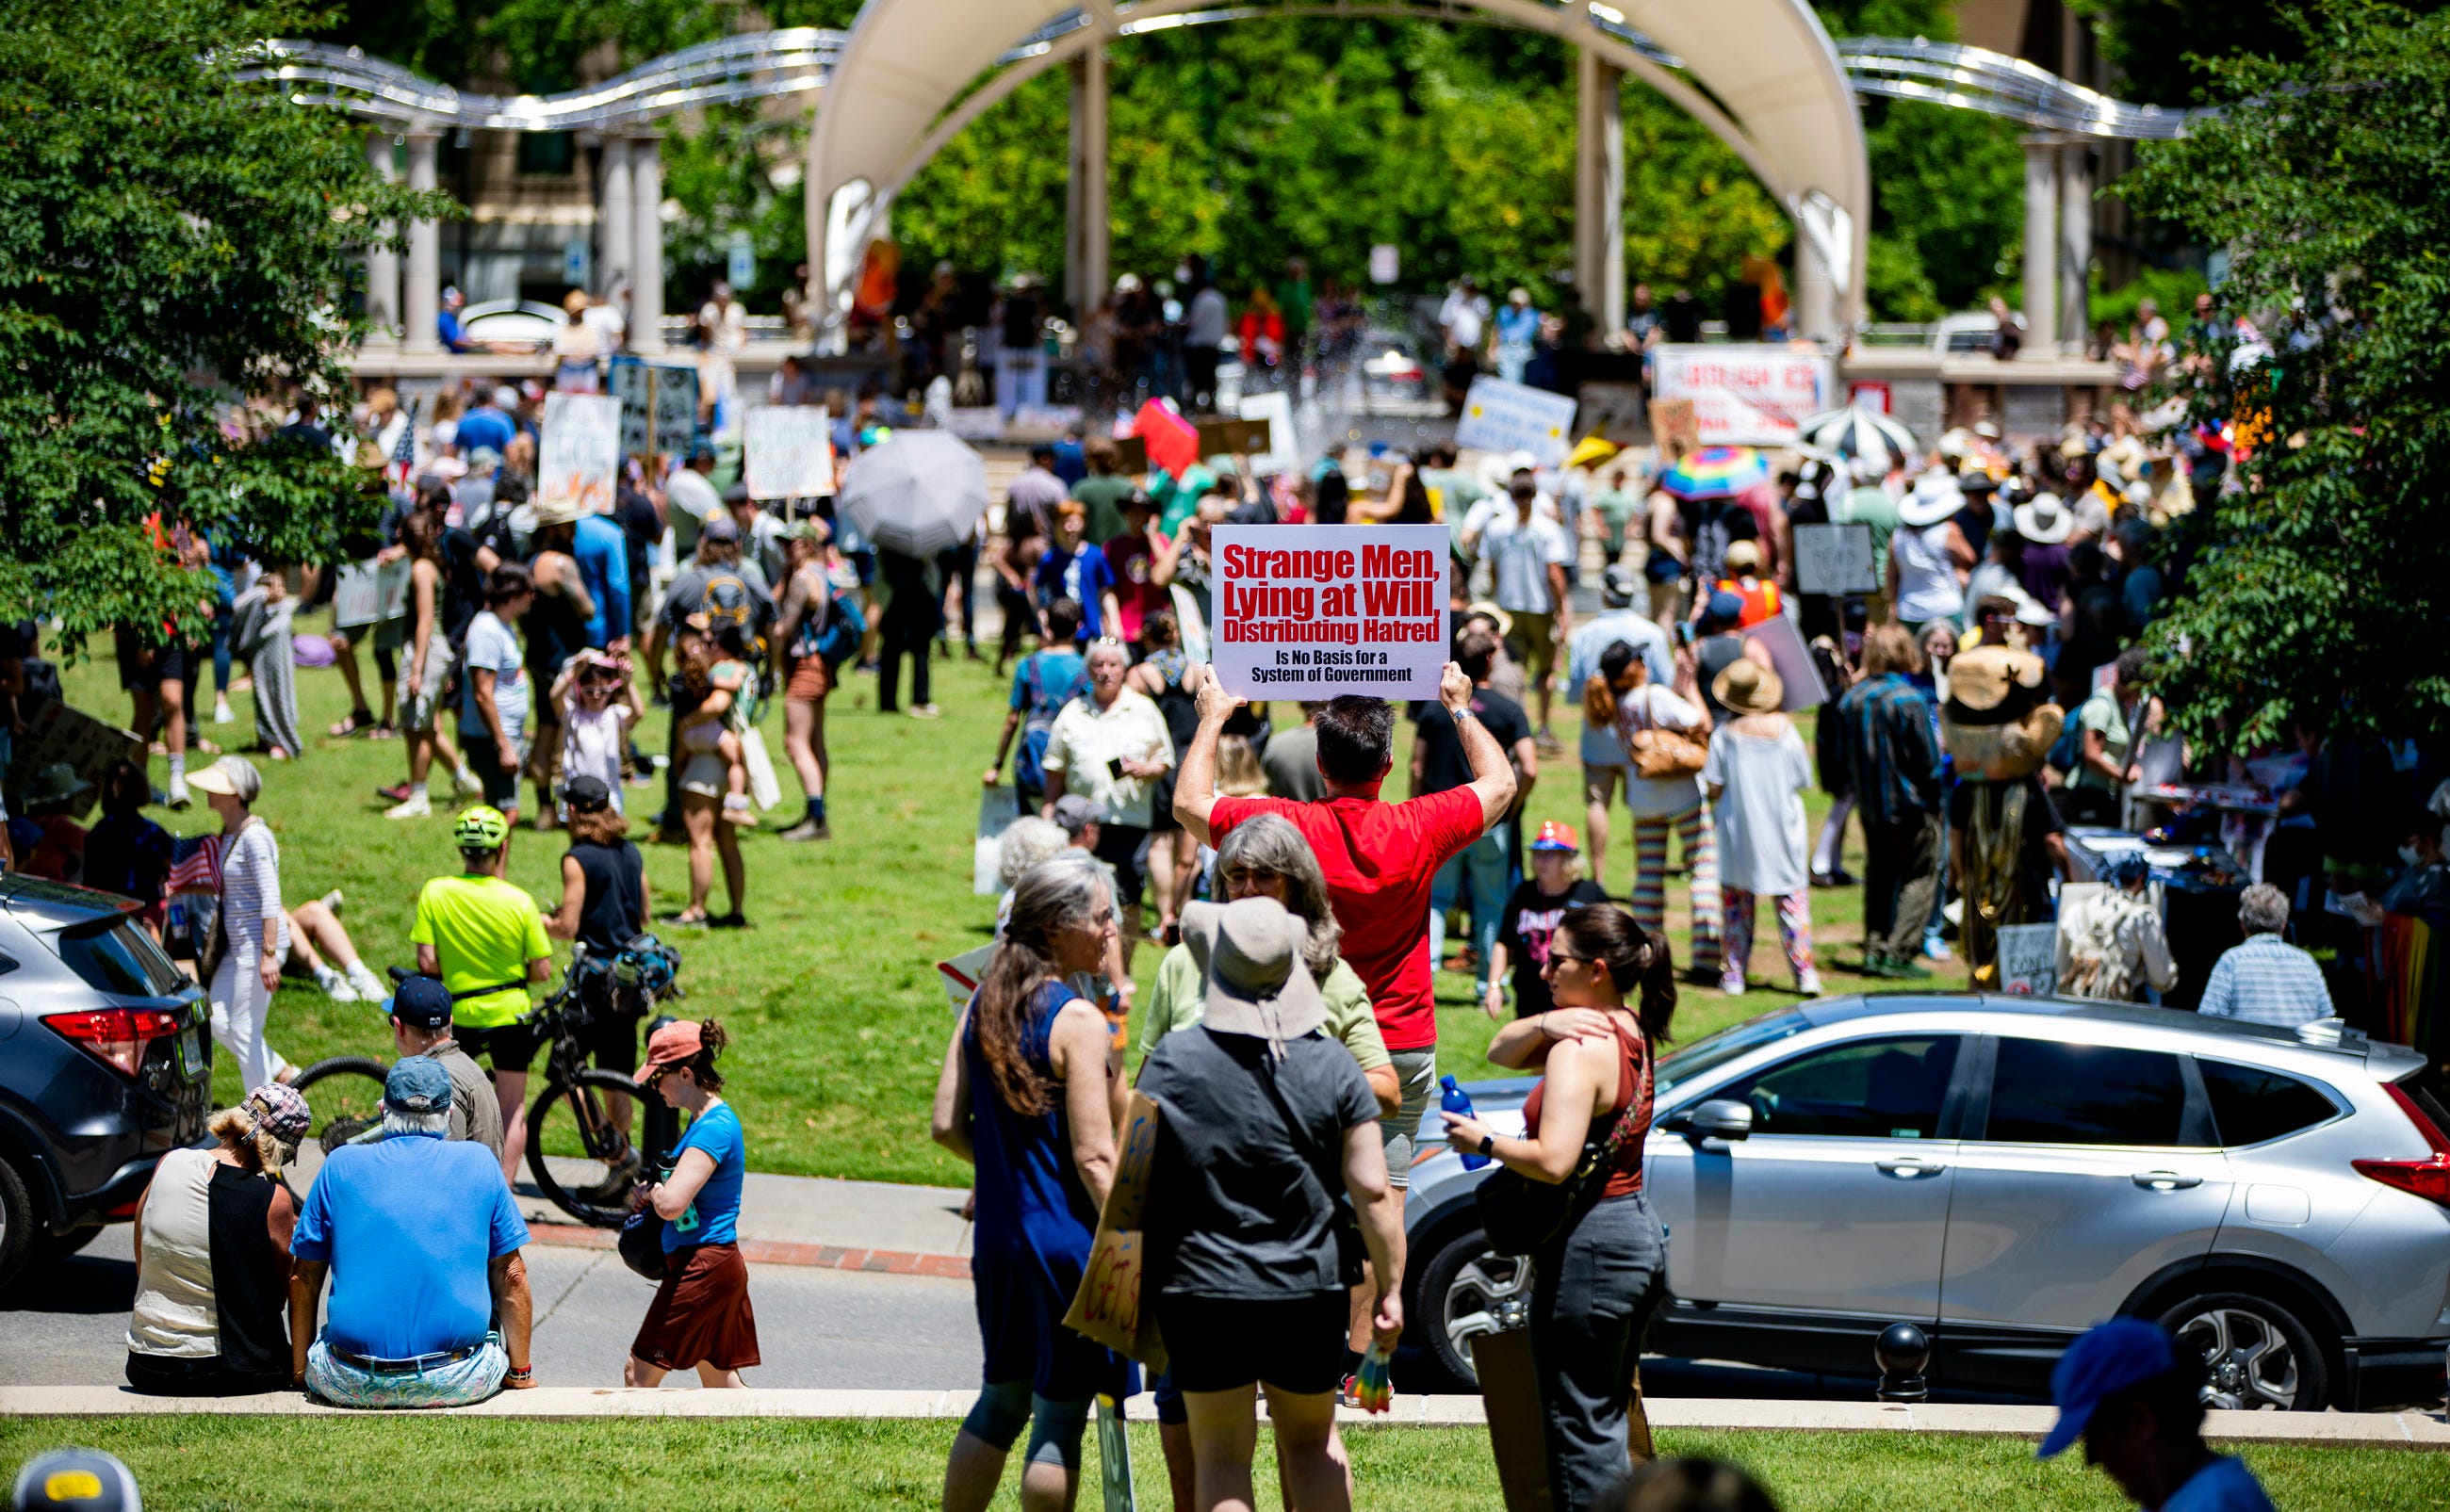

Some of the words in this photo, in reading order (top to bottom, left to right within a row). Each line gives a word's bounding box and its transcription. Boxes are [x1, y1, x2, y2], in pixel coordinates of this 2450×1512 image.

[1223, 544, 1355, 582] Strange
[1363, 545, 1440, 581] Men,
[1223, 581, 1315, 621] Lying
[1321, 584, 1357, 617] at
[1363, 581, 1440, 619] Will,
[1223, 620, 1358, 645] Distributing
[1364, 620, 1440, 642] Hatred
[1276, 649, 1289, 665] Is
[1292, 649, 1310, 665] No
[1314, 649, 1353, 665] Basis
[1356, 649, 1376, 665] for
[1379, 652, 1387, 665] a
[1251, 667, 1305, 683] System
[1308, 667, 1321, 682] of
[1325, 667, 1412, 682] Government
